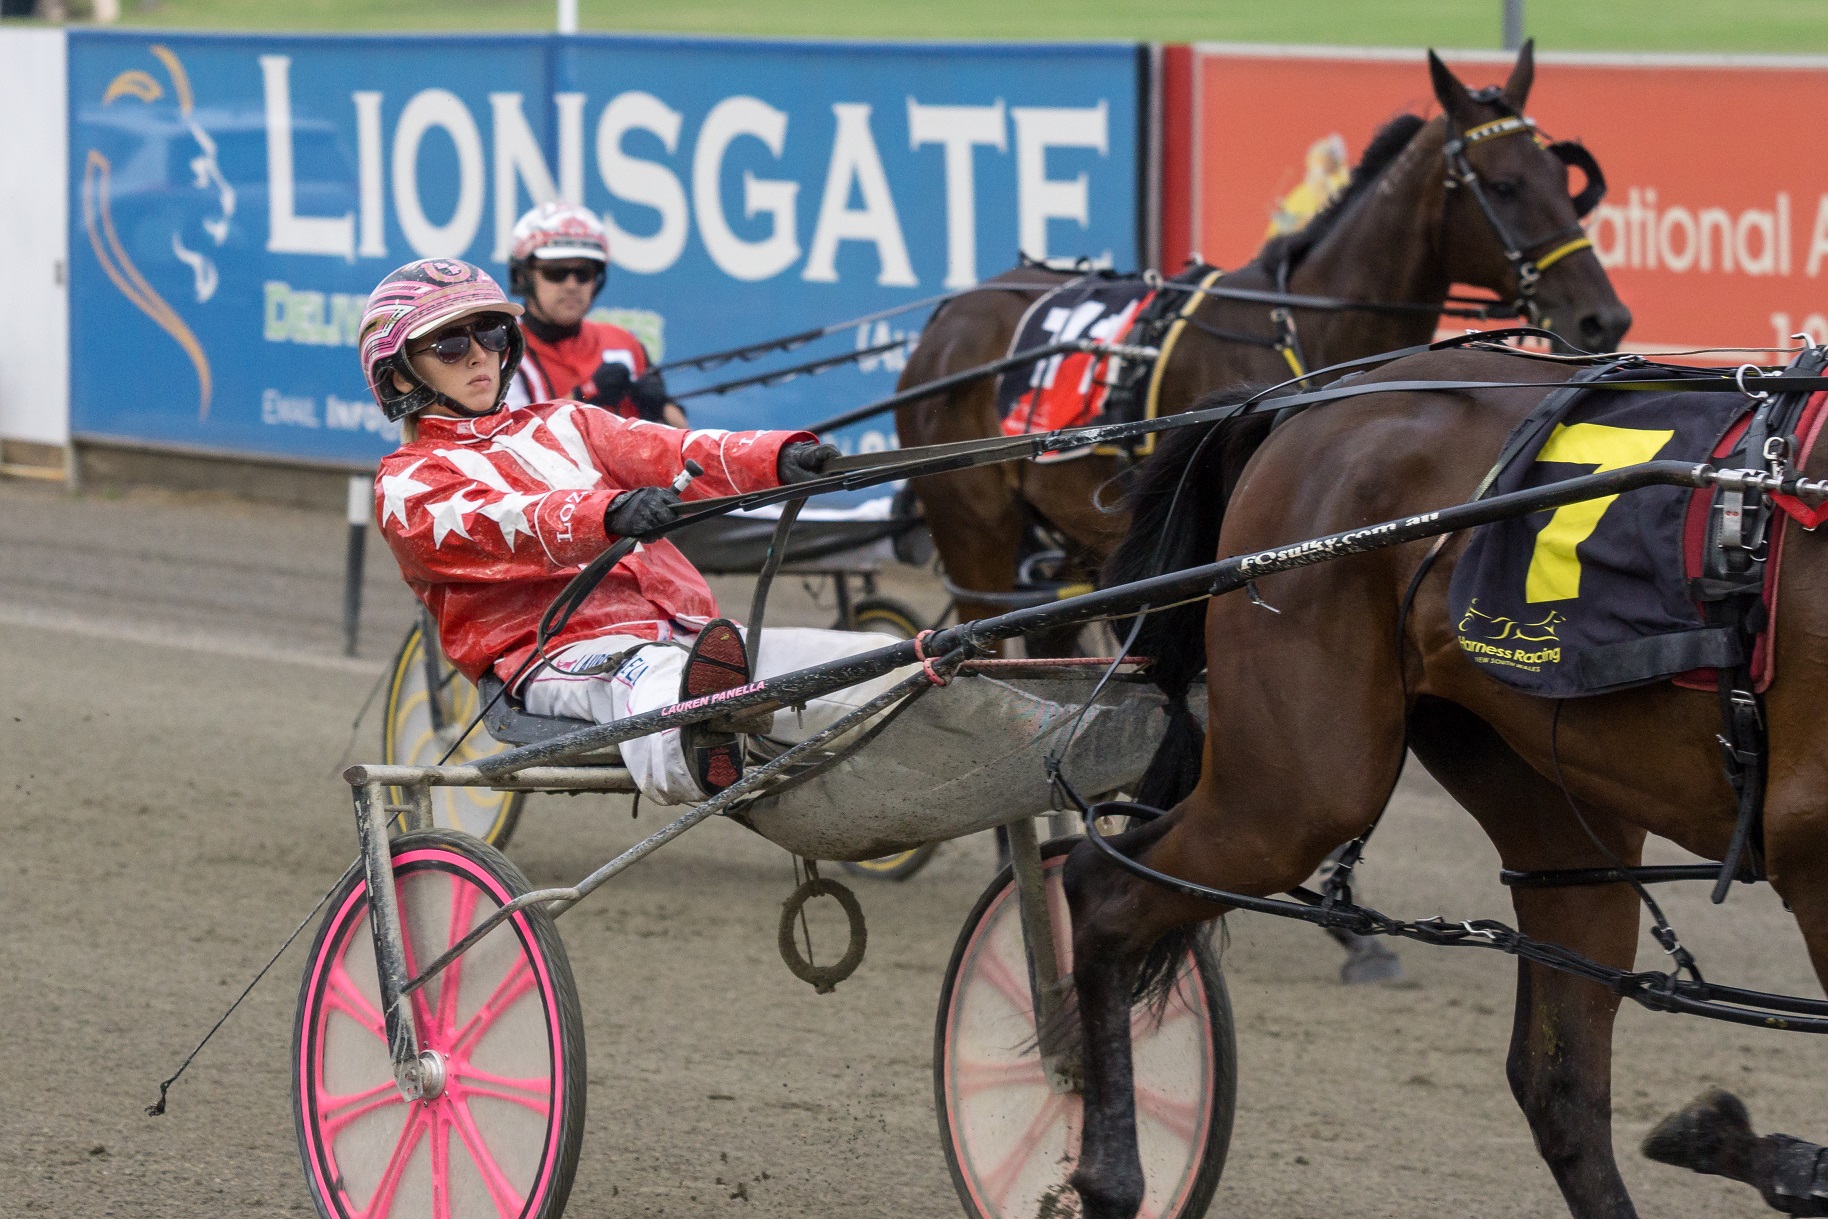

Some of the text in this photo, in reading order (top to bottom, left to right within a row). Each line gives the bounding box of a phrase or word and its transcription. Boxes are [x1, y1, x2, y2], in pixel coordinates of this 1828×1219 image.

[1586, 187, 1791, 277] ational
[1526, 422, 1675, 604] 7
[1458, 636, 1561, 663] Harness Racing
[1515, 663, 1541, 673] WALES
[661, 680, 765, 717] LAUREN PANELLA
